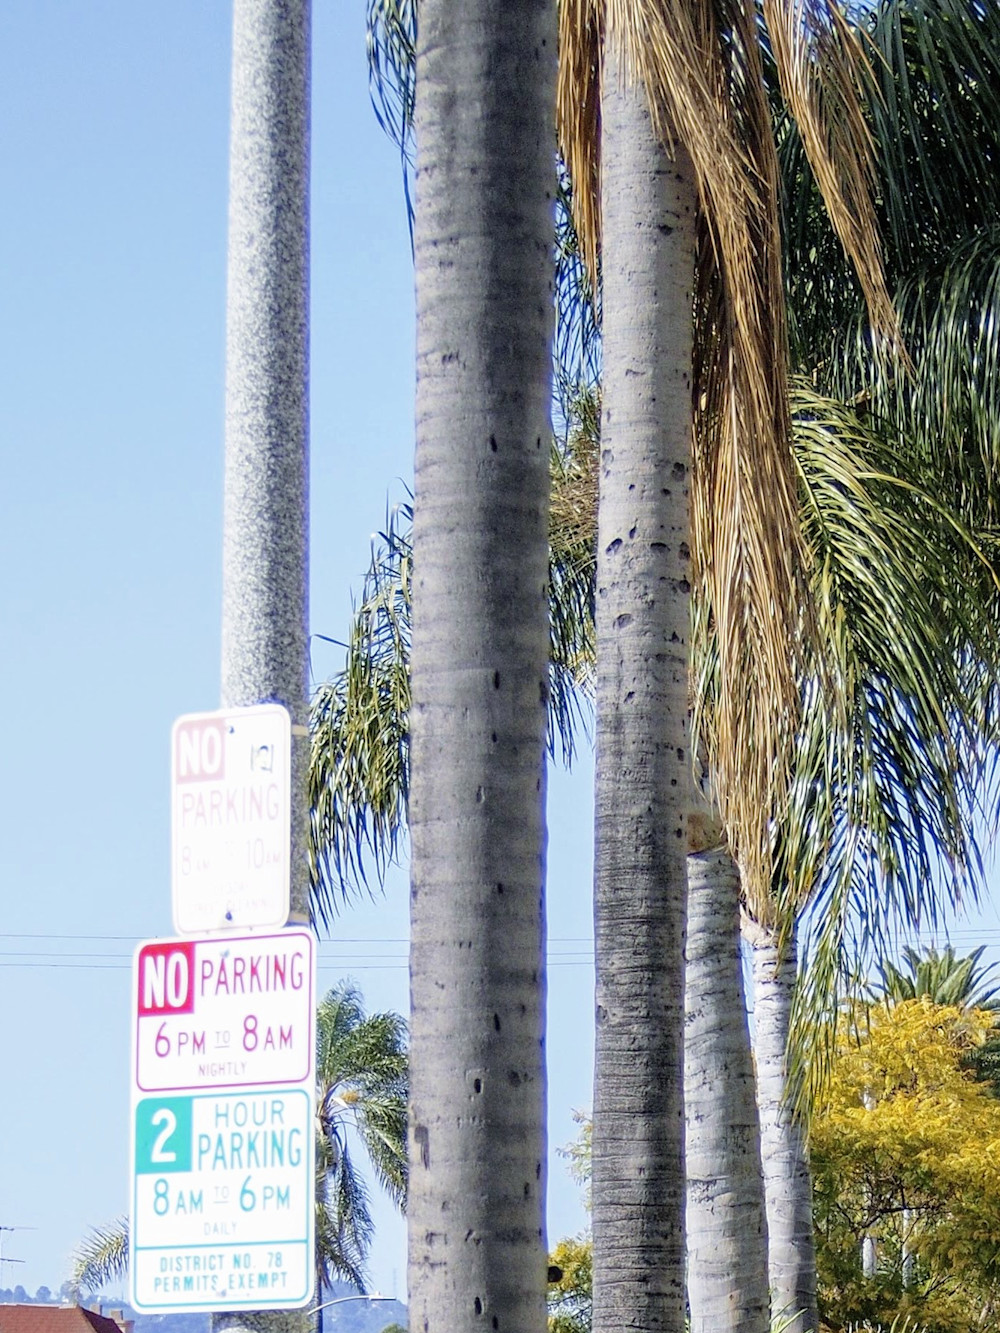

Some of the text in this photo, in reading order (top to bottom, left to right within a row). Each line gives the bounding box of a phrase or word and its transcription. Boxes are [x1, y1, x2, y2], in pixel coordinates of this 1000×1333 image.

[179, 726, 223, 777] NO
[181, 783, 280, 828] PARKING
[143, 951, 303, 1009] NO PARKING
[214, 1030, 231, 1048] TO
[198, 1060, 248, 1077] NIGHTLY
[150, 1099, 285, 1163] 2 HOUR
[198, 1127, 302, 1171] PARKING
[213, 1185, 230, 1202] TO
[203, 1222, 238, 1236] DAILY
[159, 1254, 225, 1273] DISTRICT
[267, 1251, 283, 1268] 78
[154, 1271, 288, 1293] PERMITS EXEMPT
